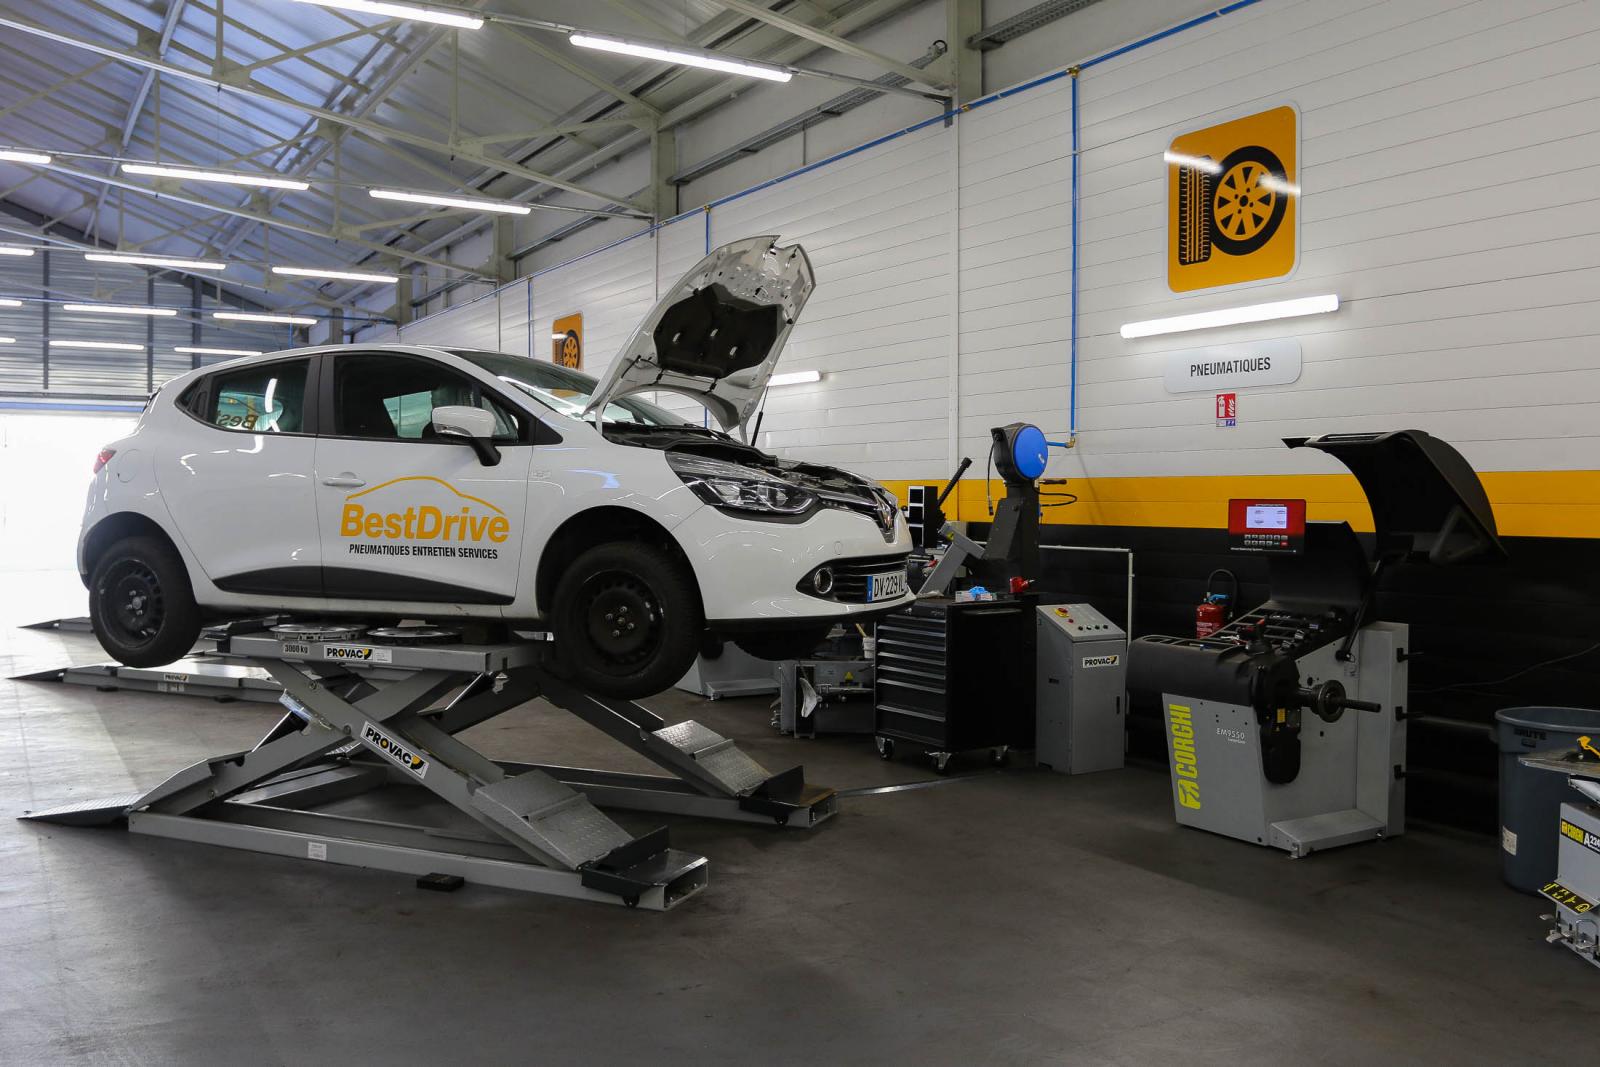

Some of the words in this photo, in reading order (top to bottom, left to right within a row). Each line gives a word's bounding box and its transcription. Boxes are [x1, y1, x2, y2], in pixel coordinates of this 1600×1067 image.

[1190, 356, 1271, 377] PNEUMATIQUES
[340, 503, 510, 543] BestDrive
[349, 544, 410, 556] PNEUMATIQUES
[412, 546, 456, 557] ENTRETIEN
[458, 547, 498, 559] SERVICES
[284, 644, 300, 654] 3000
[300, 645, 308, 654] kg
[326, 647, 363, 659] PROVAC
[1084, 657, 1111, 666] PROVAC
[1168, 703, 1197, 779] CORGHI
[1216, 727, 1245, 740] EM9550
[365, 727, 412, 765] PROVAC
